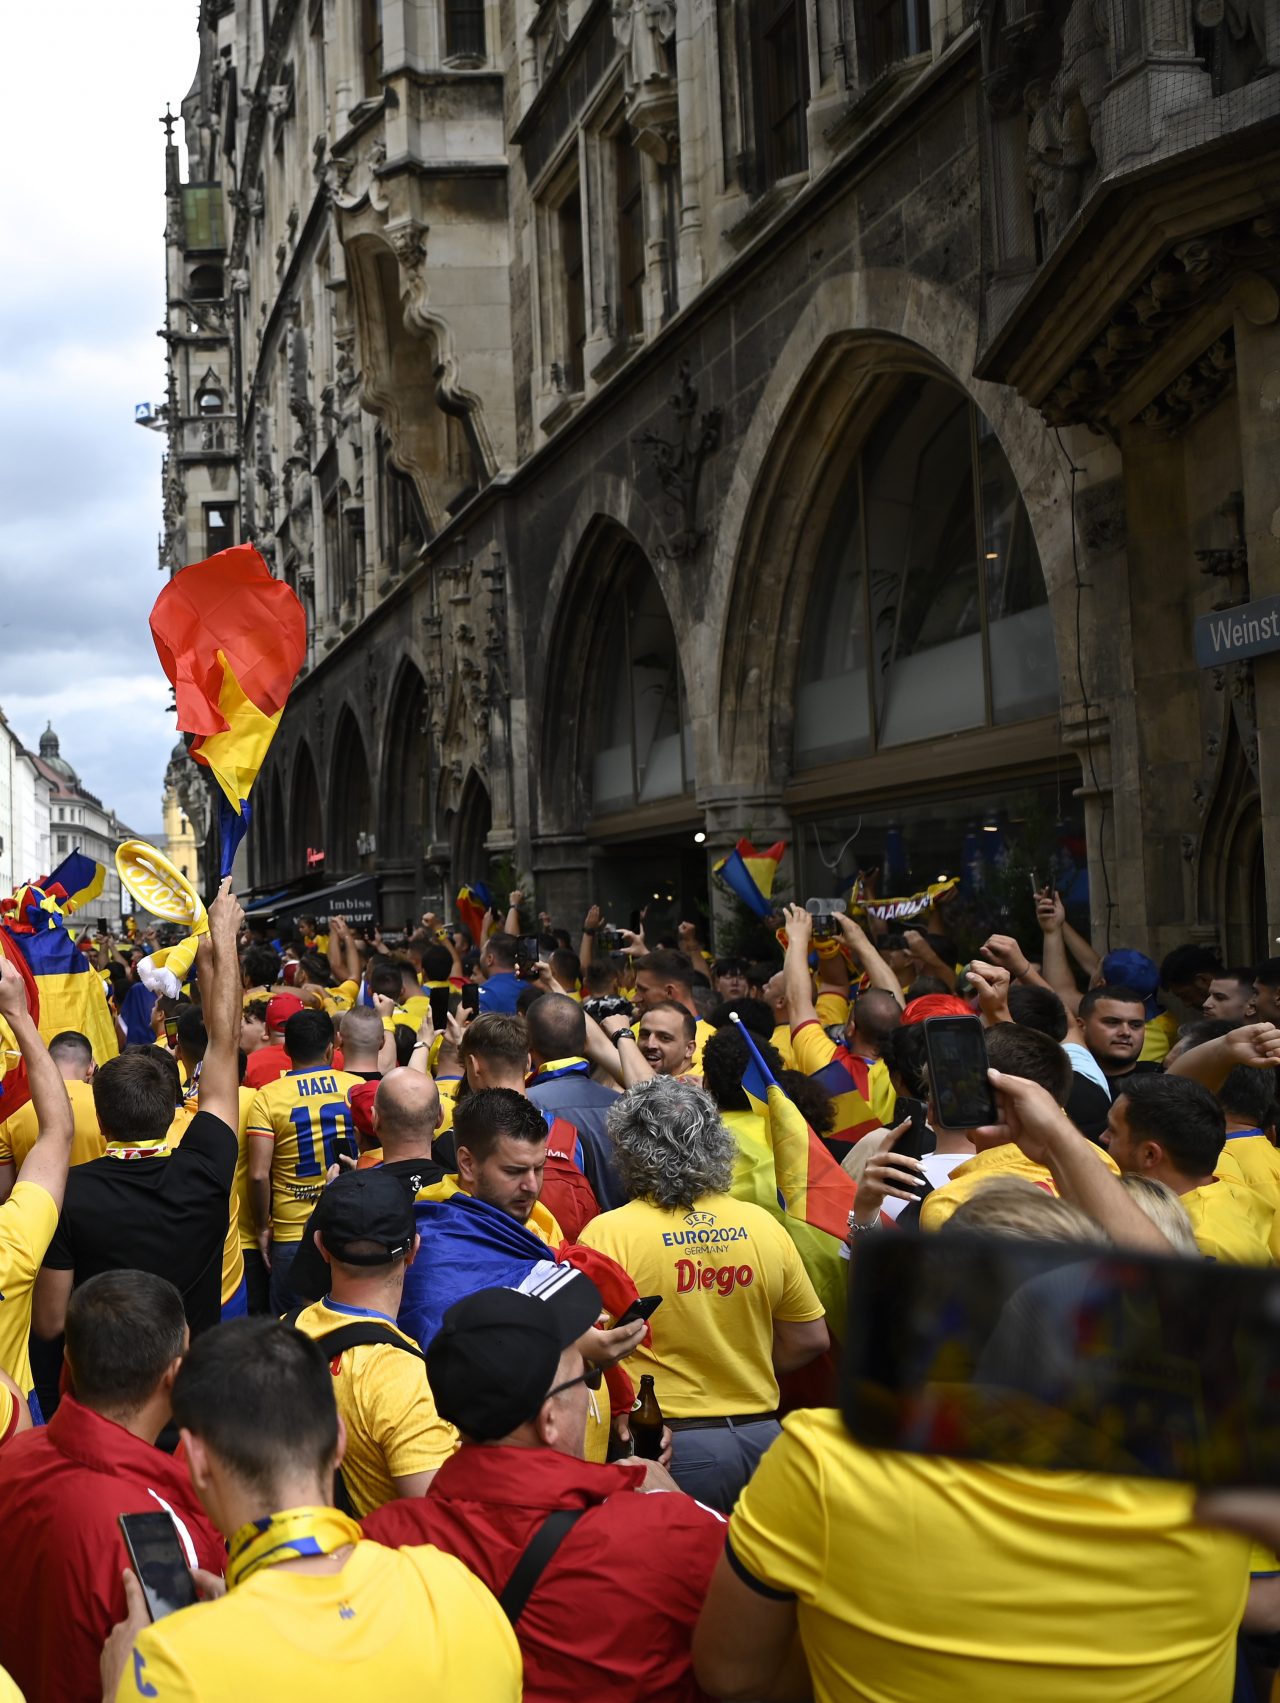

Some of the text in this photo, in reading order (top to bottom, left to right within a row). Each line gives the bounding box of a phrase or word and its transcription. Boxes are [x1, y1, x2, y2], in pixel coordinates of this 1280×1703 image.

[329, 899, 372, 910] Imbiss
[297, 1076, 338, 1096] HAGI
[289, 1102, 359, 1177] 10
[685, 1213, 716, 1226] UEFA
[662, 1227, 748, 1247] EURO2024
[684, 1245, 729, 1256] GERMANY
[674, 1258, 755, 1297] Diego
